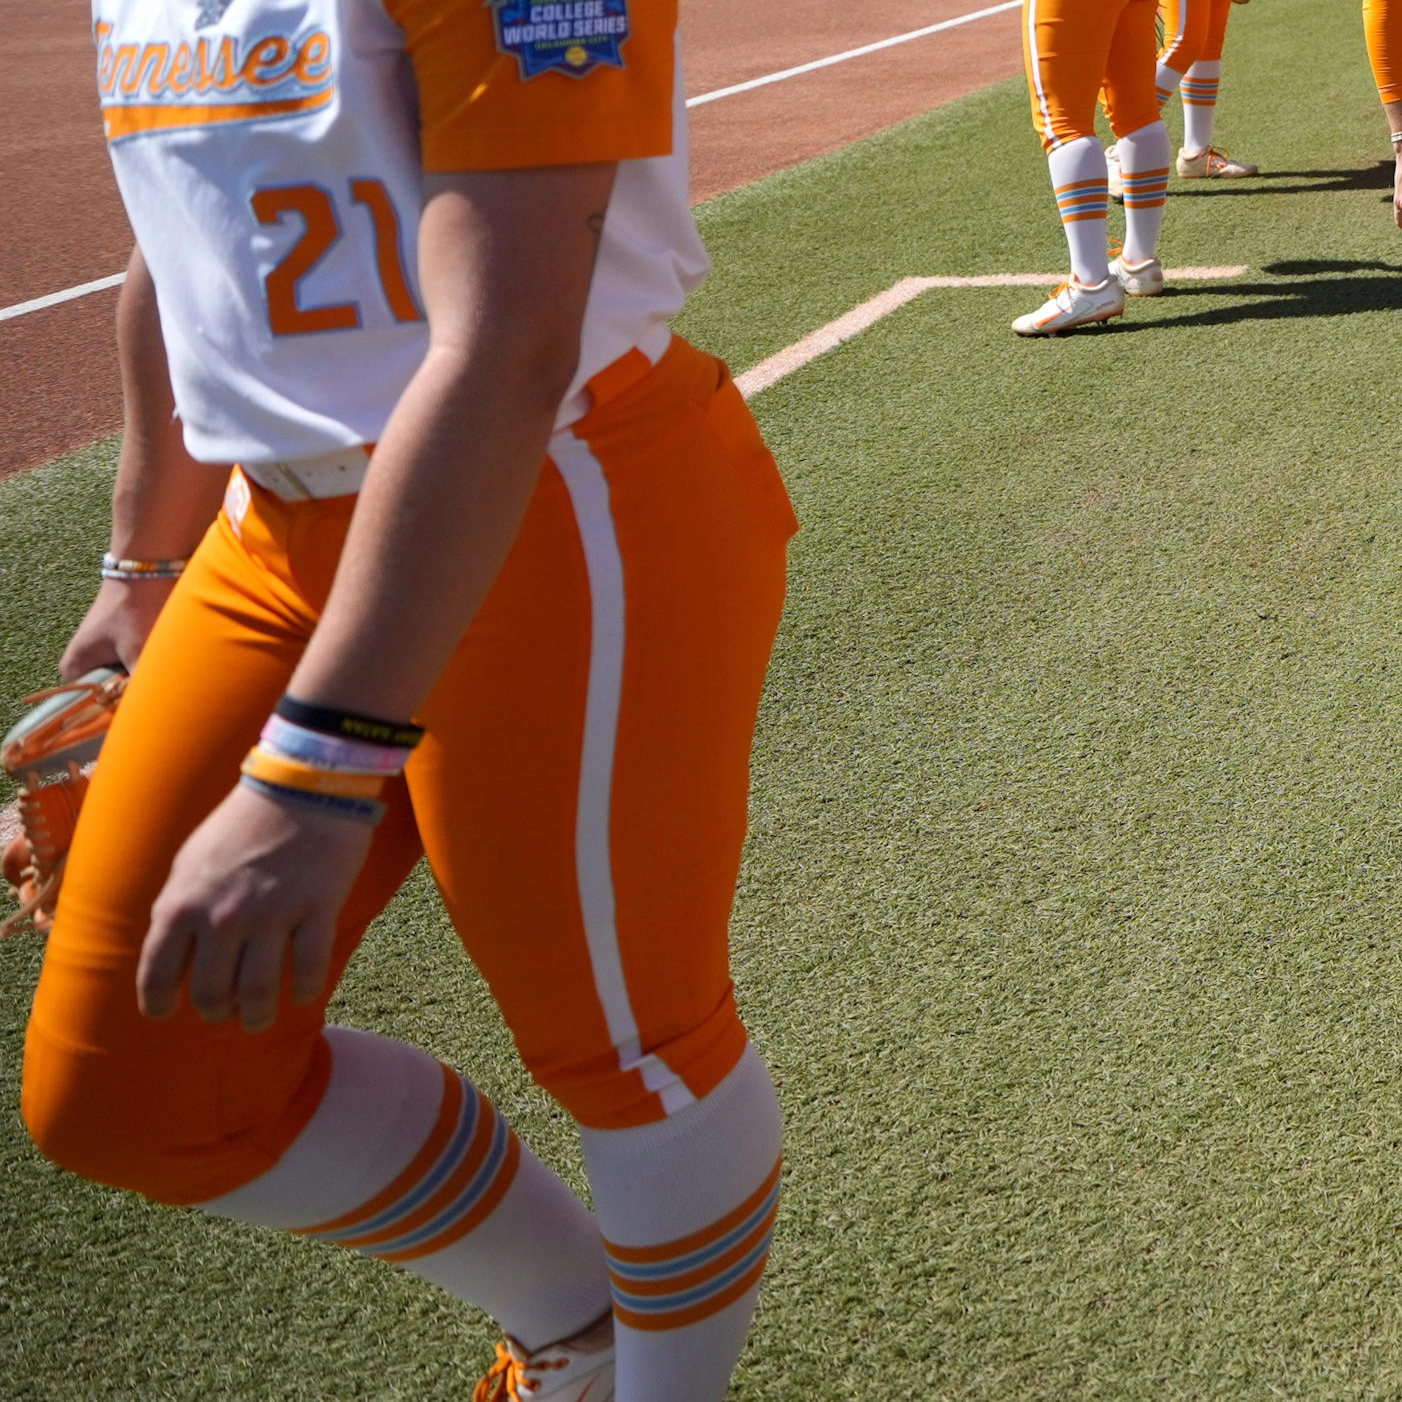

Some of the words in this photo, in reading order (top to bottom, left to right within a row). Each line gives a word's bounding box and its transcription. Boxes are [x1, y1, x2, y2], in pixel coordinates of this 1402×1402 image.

[530, 1, 604, 23] COLLEGE
[503, 21, 571, 46] WORLD
[573, 15, 627, 38] SERIES
[250, 174, 423, 339] 21
